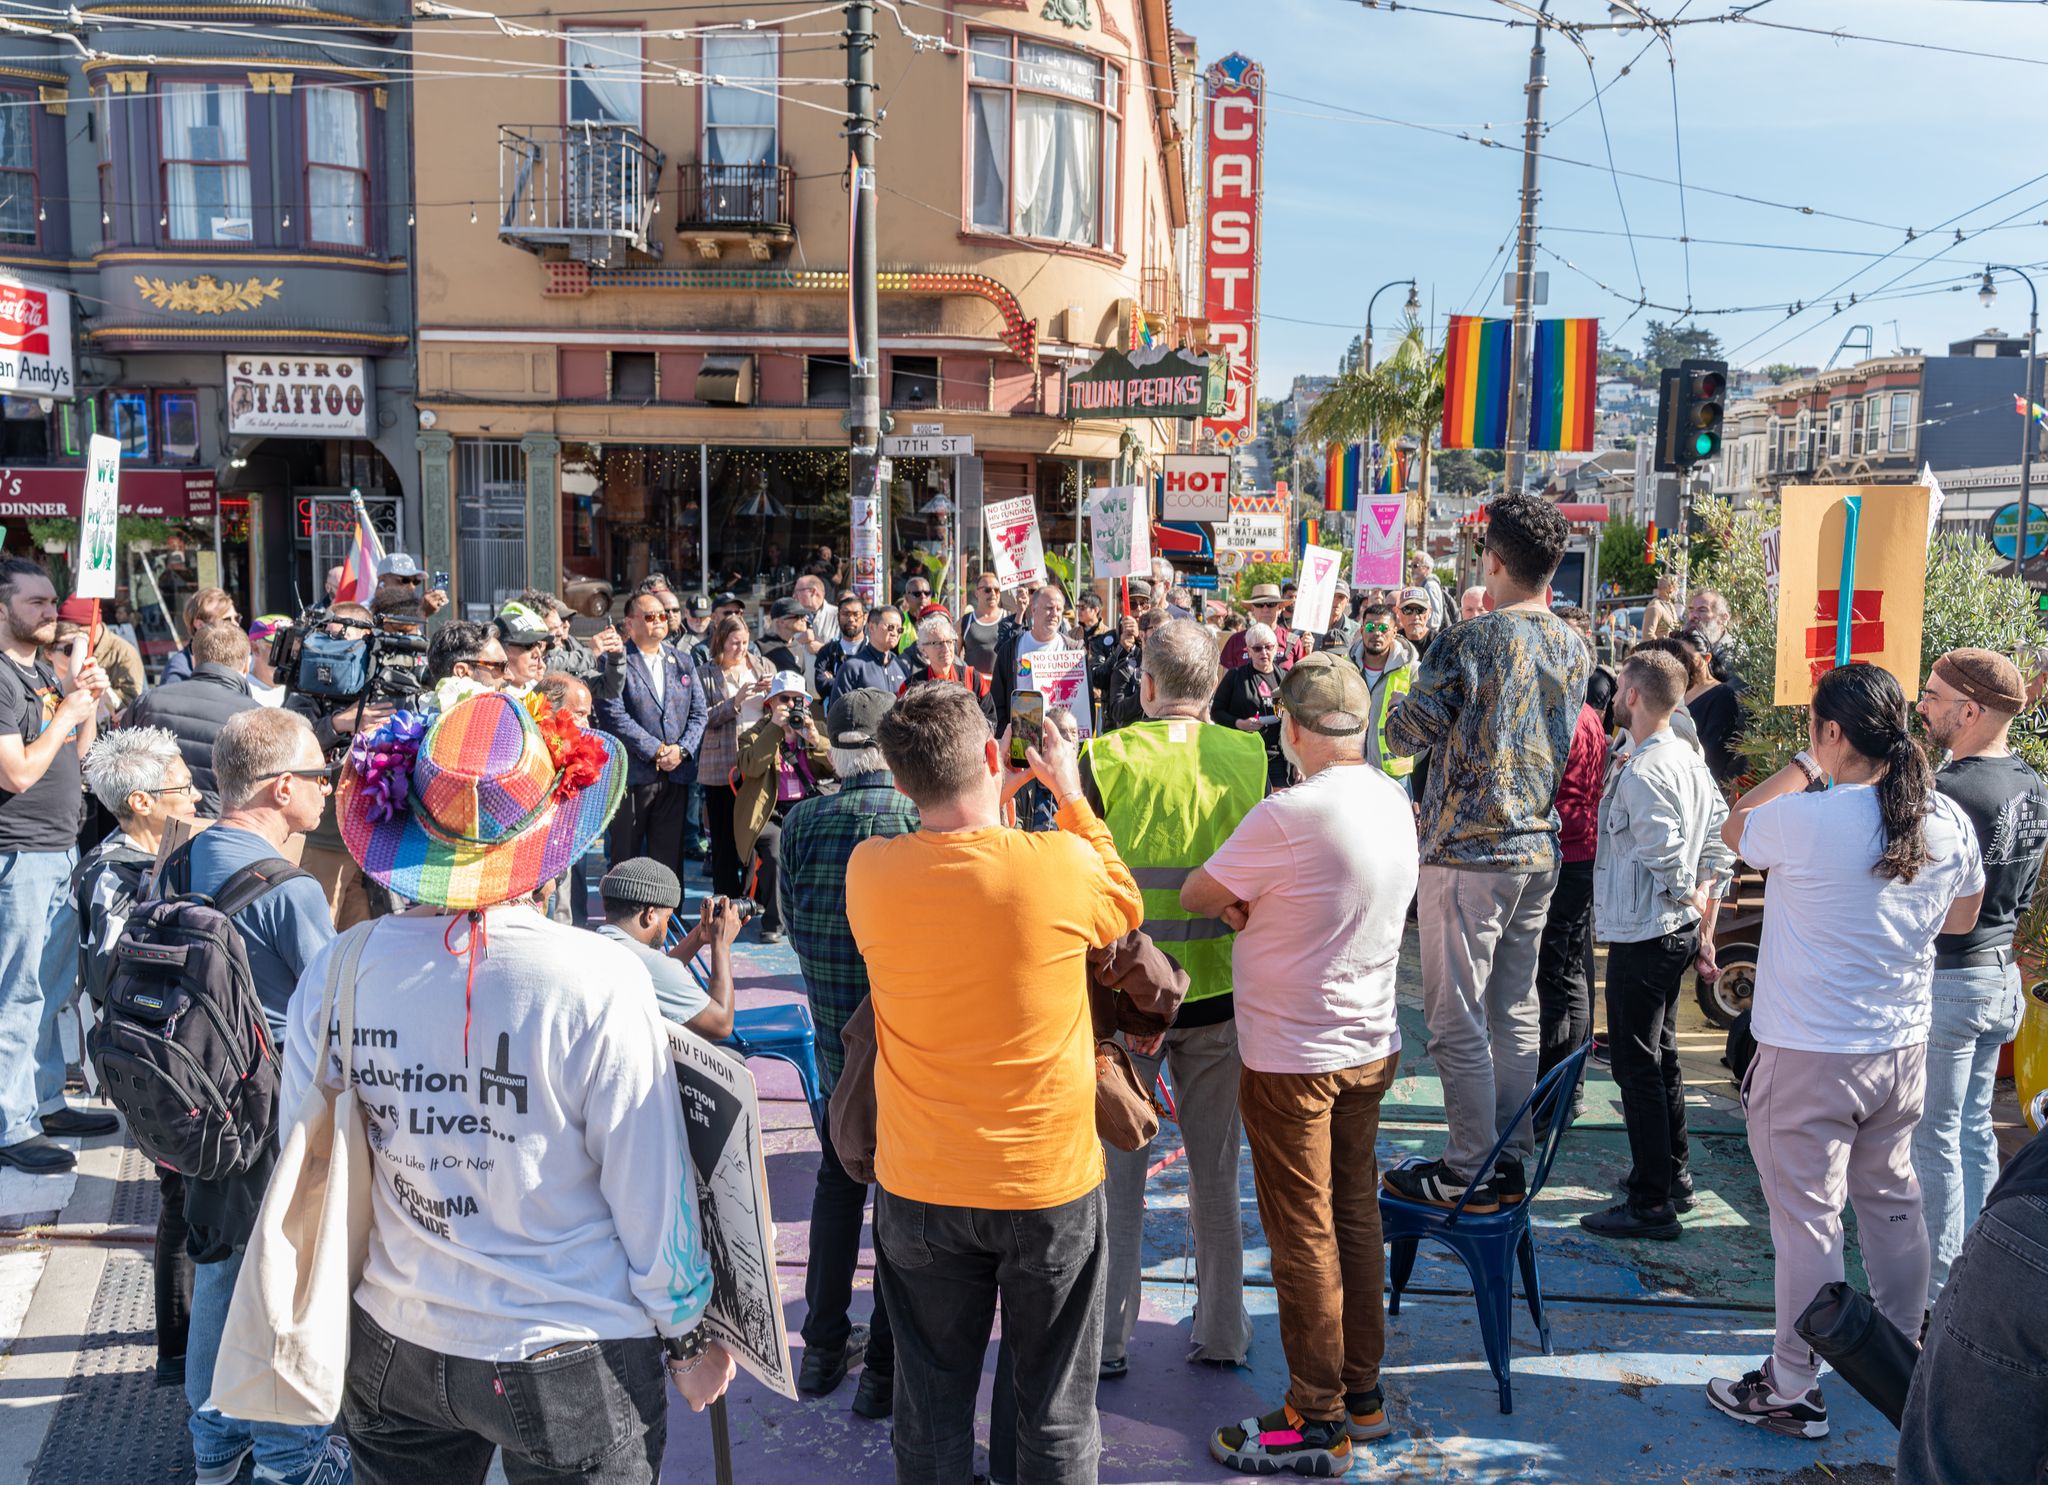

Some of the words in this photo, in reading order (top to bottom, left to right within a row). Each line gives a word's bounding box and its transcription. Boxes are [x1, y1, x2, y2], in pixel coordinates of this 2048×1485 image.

[20, 356, 69, 392] Andy's
[238, 361, 353, 378] CASTRO
[254, 383, 364, 416] TATTOO
[1070, 379, 1125, 409] TWIN
[1127, 375, 1202, 406] PEAKS
[897, 440, 928, 451] 17TH
[942, 440, 957, 451] ST
[1166, 471, 1226, 492] HOT
[1, 503, 67, 515] DINNER
[1000, 501, 1019, 511] CUTS
[1021, 498, 1032, 506] TO
[1165, 494, 1226, 508] COOKIE
[1001, 506, 1033, 519] FUNDING
[1235, 528, 1277, 536] WATANABE
[1048, 661, 1084, 669] FUNDING
[668, 1034, 690, 1056] HIV
[690, 1108, 710, 1128] LIFE
[384, 1147, 402, 1163] You
[405, 1154, 426, 1171] Like
[430, 1158, 439, 1171] It
[442, 1155, 463, 1168] Or
[742, 1346, 786, 1384] FRANCISCO
